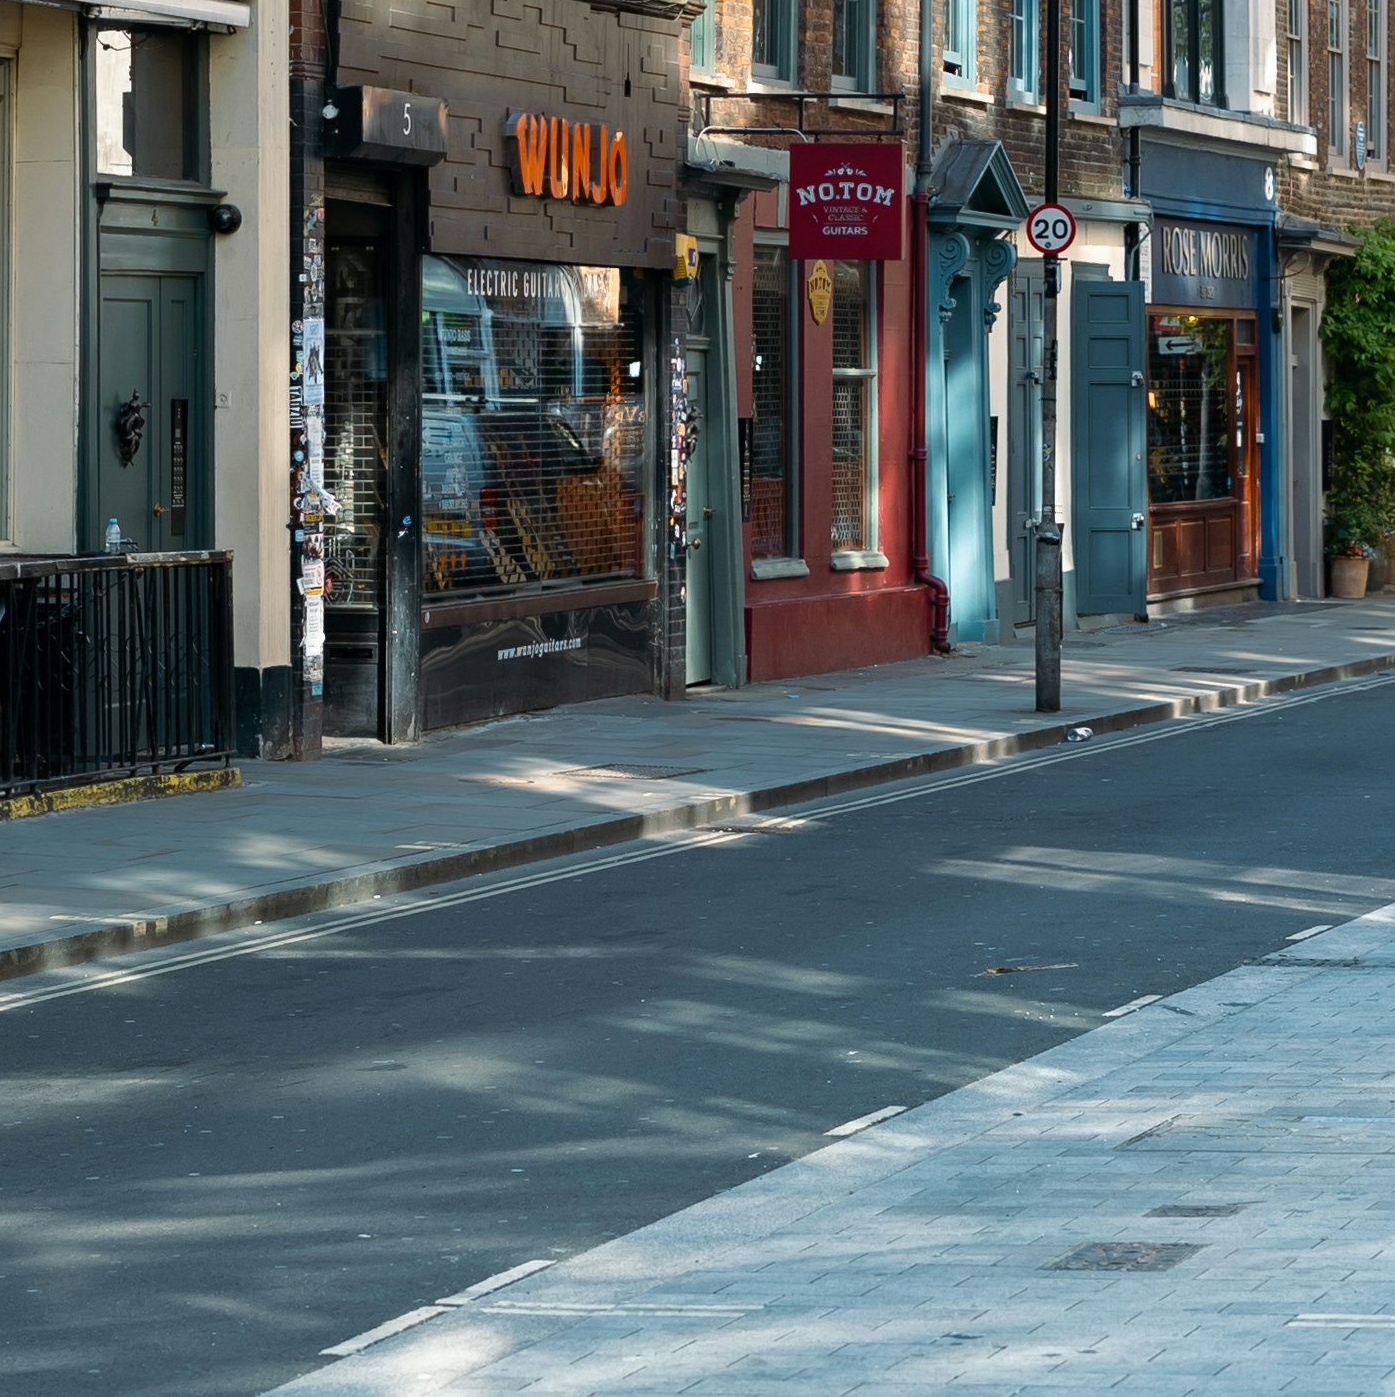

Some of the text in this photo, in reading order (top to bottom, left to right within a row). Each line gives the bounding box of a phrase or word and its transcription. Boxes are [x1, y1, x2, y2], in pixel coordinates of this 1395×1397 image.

[402, 103, 412, 135] 5
[514, 113, 627, 206] WUNJO
[796, 182, 895, 206] NO.TOM
[1265, 167, 1274, 200] 8
[151, 208, 159, 226] 4
[824, 206, 858, 214] VINTAGE
[828, 214, 864, 222] CLASSIC
[822, 226, 868, 235] GUITARS
[1034, 219, 1068, 239] 20
[1163, 227, 1196, 276] ROSE
[1200, 231, 1249, 280] MORRIS
[467, 268, 518, 298] ELECTRIC
[523, 271, 567, 300] GUITARS
[497, 637, 581, 661] www.wunjoguitars.com
